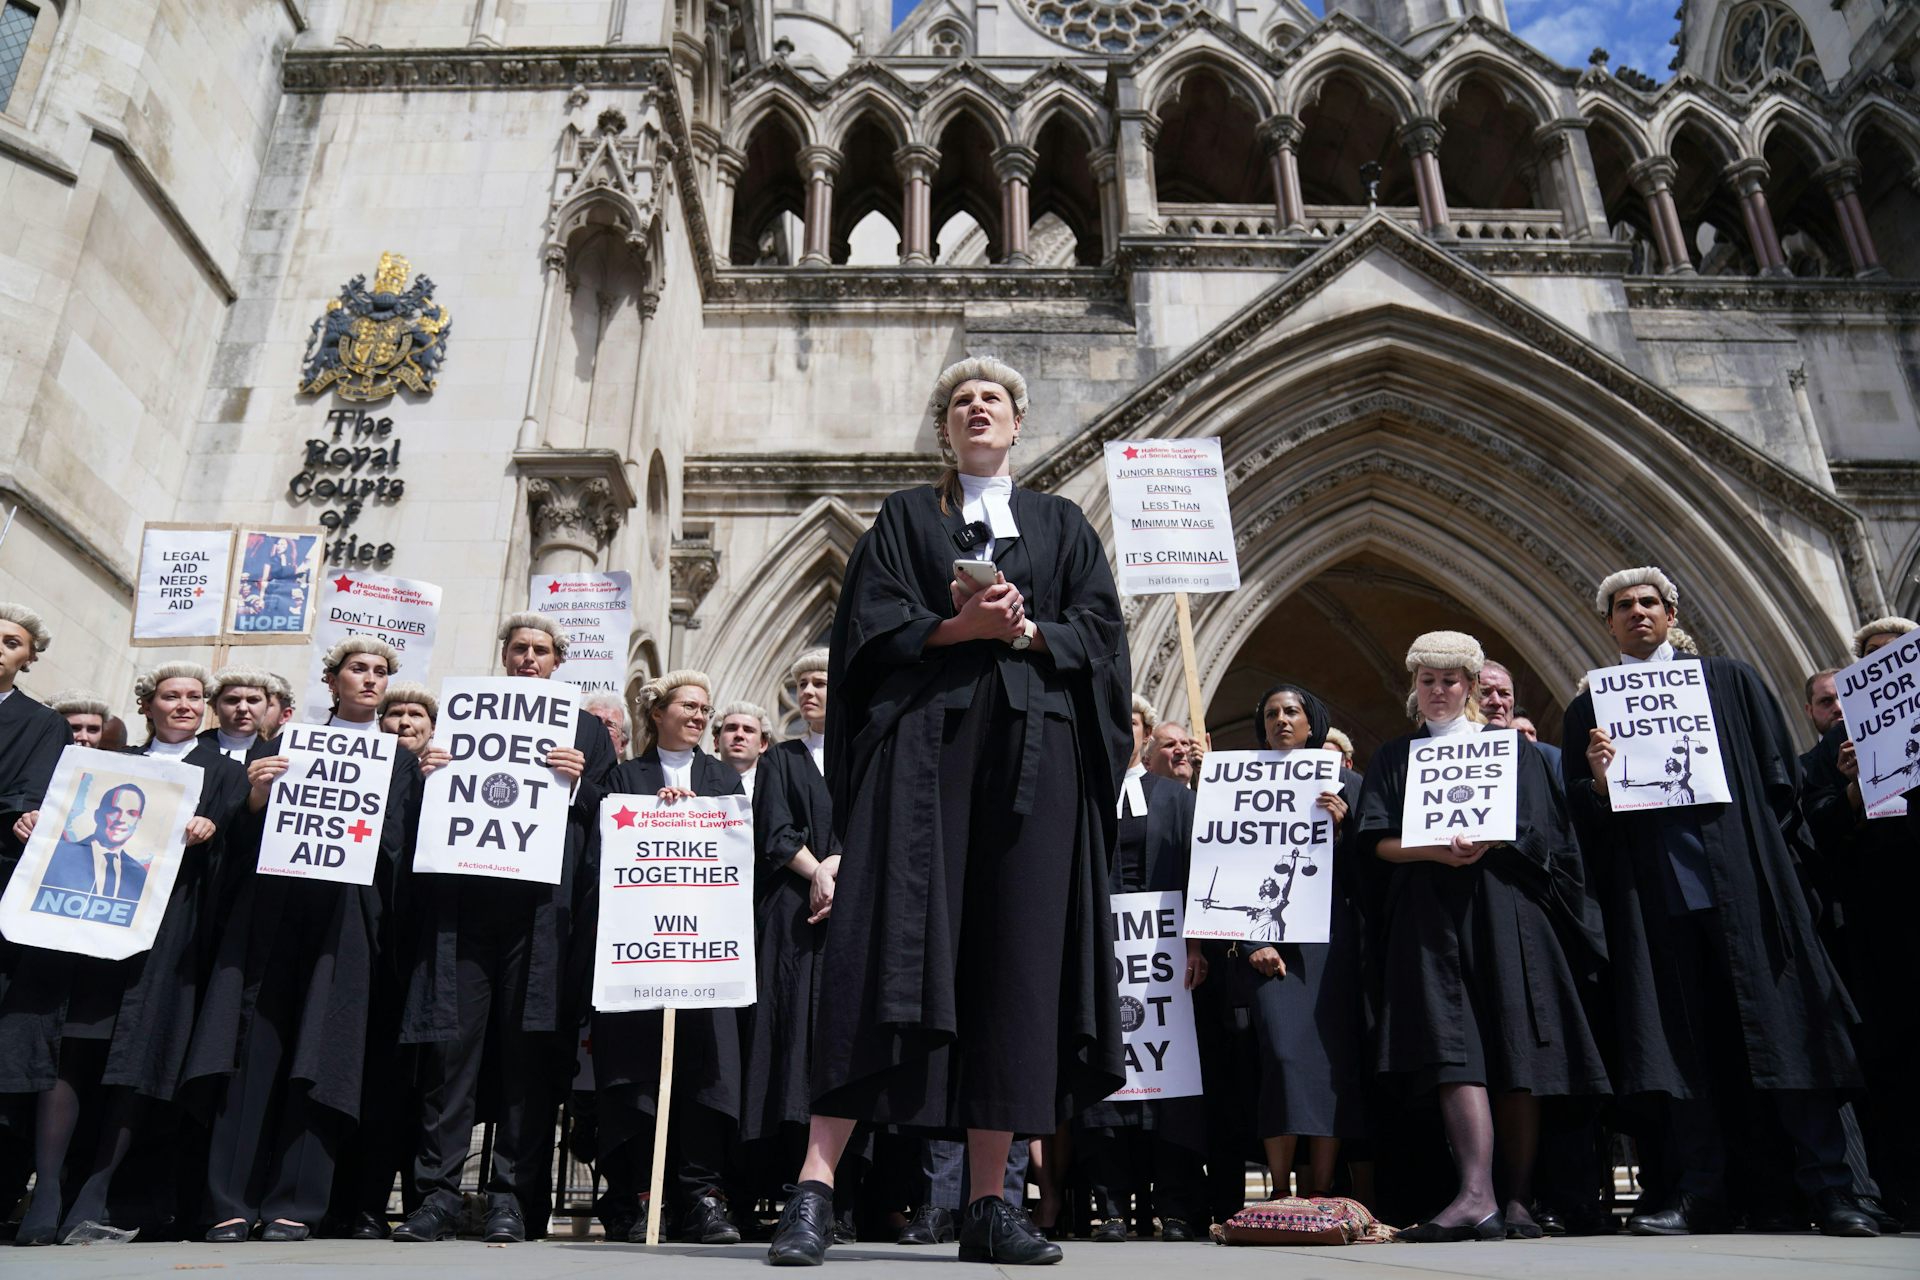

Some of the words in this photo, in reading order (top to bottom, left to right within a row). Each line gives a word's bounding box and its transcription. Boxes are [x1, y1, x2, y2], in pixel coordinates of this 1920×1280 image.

[328, 409, 393, 435] The
[304, 439, 401, 472] Royal
[1157, 468, 1217, 477] BARRISTERS
[289, 471, 405, 498] Courts
[1146, 484, 1192, 493] EARNING
[320, 500, 363, 528] of
[163, 551, 210, 561] LEGAL
[1126, 552, 1152, 563] IT'S
[1157, 551, 1229, 563] CRIMINAL
[172, 563, 198, 574] AID
[159, 575, 208, 586] NEEDS
[356, 581, 390, 592] Haldane
[392, 587, 422, 598] Society
[1149, 575, 1209, 585] haldane.org
[168, 599, 193, 610] AID
[362, 590, 398, 601] Socialist
[400, 596, 433, 606] Lawyers
[572, 600, 626, 609] BARRISTERS
[239, 615, 300, 630] HOPE
[1595, 669, 1700, 694] JUSTICE
[1869, 673, 1916, 708] FOR
[447, 693, 571, 728] CRIME
[1625, 694, 1677, 713] FOR
[1856, 691, 1920, 742] JUSTI
[1608, 715, 1711, 740] JUSTICE
[289, 730, 388, 761] LEGAL
[451, 733, 558, 769] DOES
[1416, 740, 1510, 762] CRIME
[306, 758, 361, 784] AID
[1204, 760, 1333, 783] JUSTICE
[1420, 764, 1502, 784] DOES
[276, 782, 381, 815] NEEDS
[1234, 790, 1296, 812] FOR
[638, 820, 648, 828] of
[651, 820, 697, 828] Socialist
[700, 819, 744, 829] Lawyers
[641, 811, 685, 819] Haldane
[688, 811, 727, 820] Society
[1425, 807, 1491, 829] PAY
[447, 817, 539, 852] PAY
[1197, 820, 1328, 845] JUSTICE
[290, 842, 346, 868] AID
[636, 841, 718, 858] STRIKE
[259, 866, 306, 875] #Action4Justice
[457, 861, 520, 873] #Action4Justice
[614, 866, 739, 884] TOGETHER
[38, 890, 131, 924] NOPE
[654, 915, 698, 932] WIN
[1111, 909, 1177, 941] IME
[1186, 929, 1244, 937] #Action4Justice
[612, 940, 739, 960] TOGETHER
[634, 986, 715, 998] haldane.org
[1124, 1040, 1170, 1072] AY
